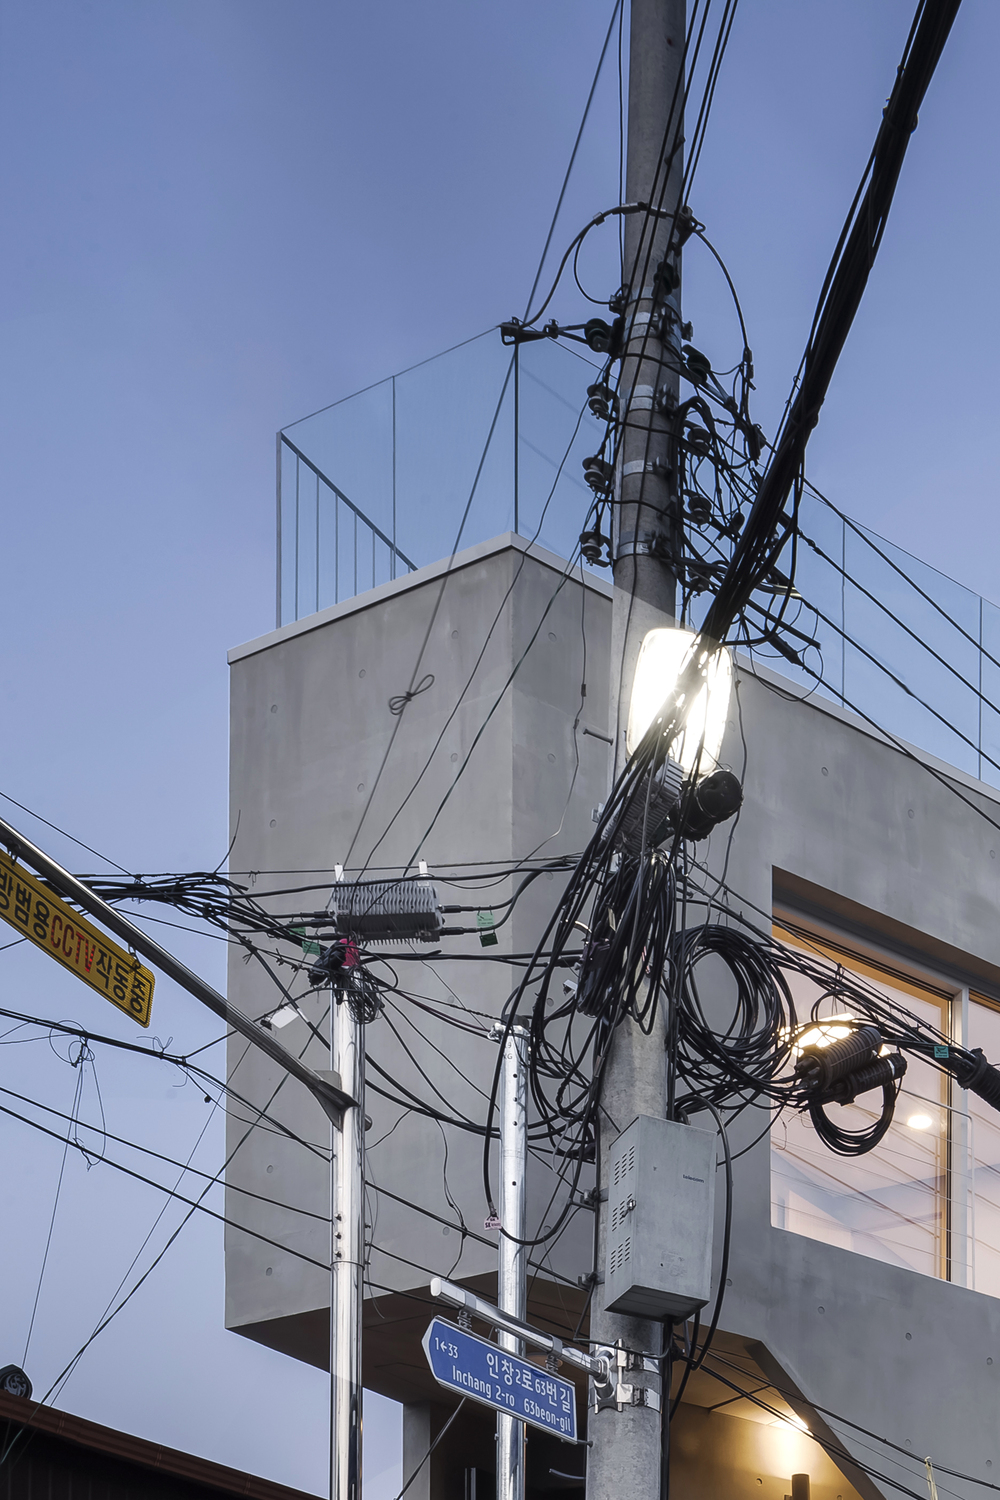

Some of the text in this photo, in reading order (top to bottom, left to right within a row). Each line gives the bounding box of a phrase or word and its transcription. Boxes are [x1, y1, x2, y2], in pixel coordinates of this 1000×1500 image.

[434, 1337, 458, 1358] 1 33
[452, 1365, 571, 1432] Inchang 2-ro 63beon-gil
